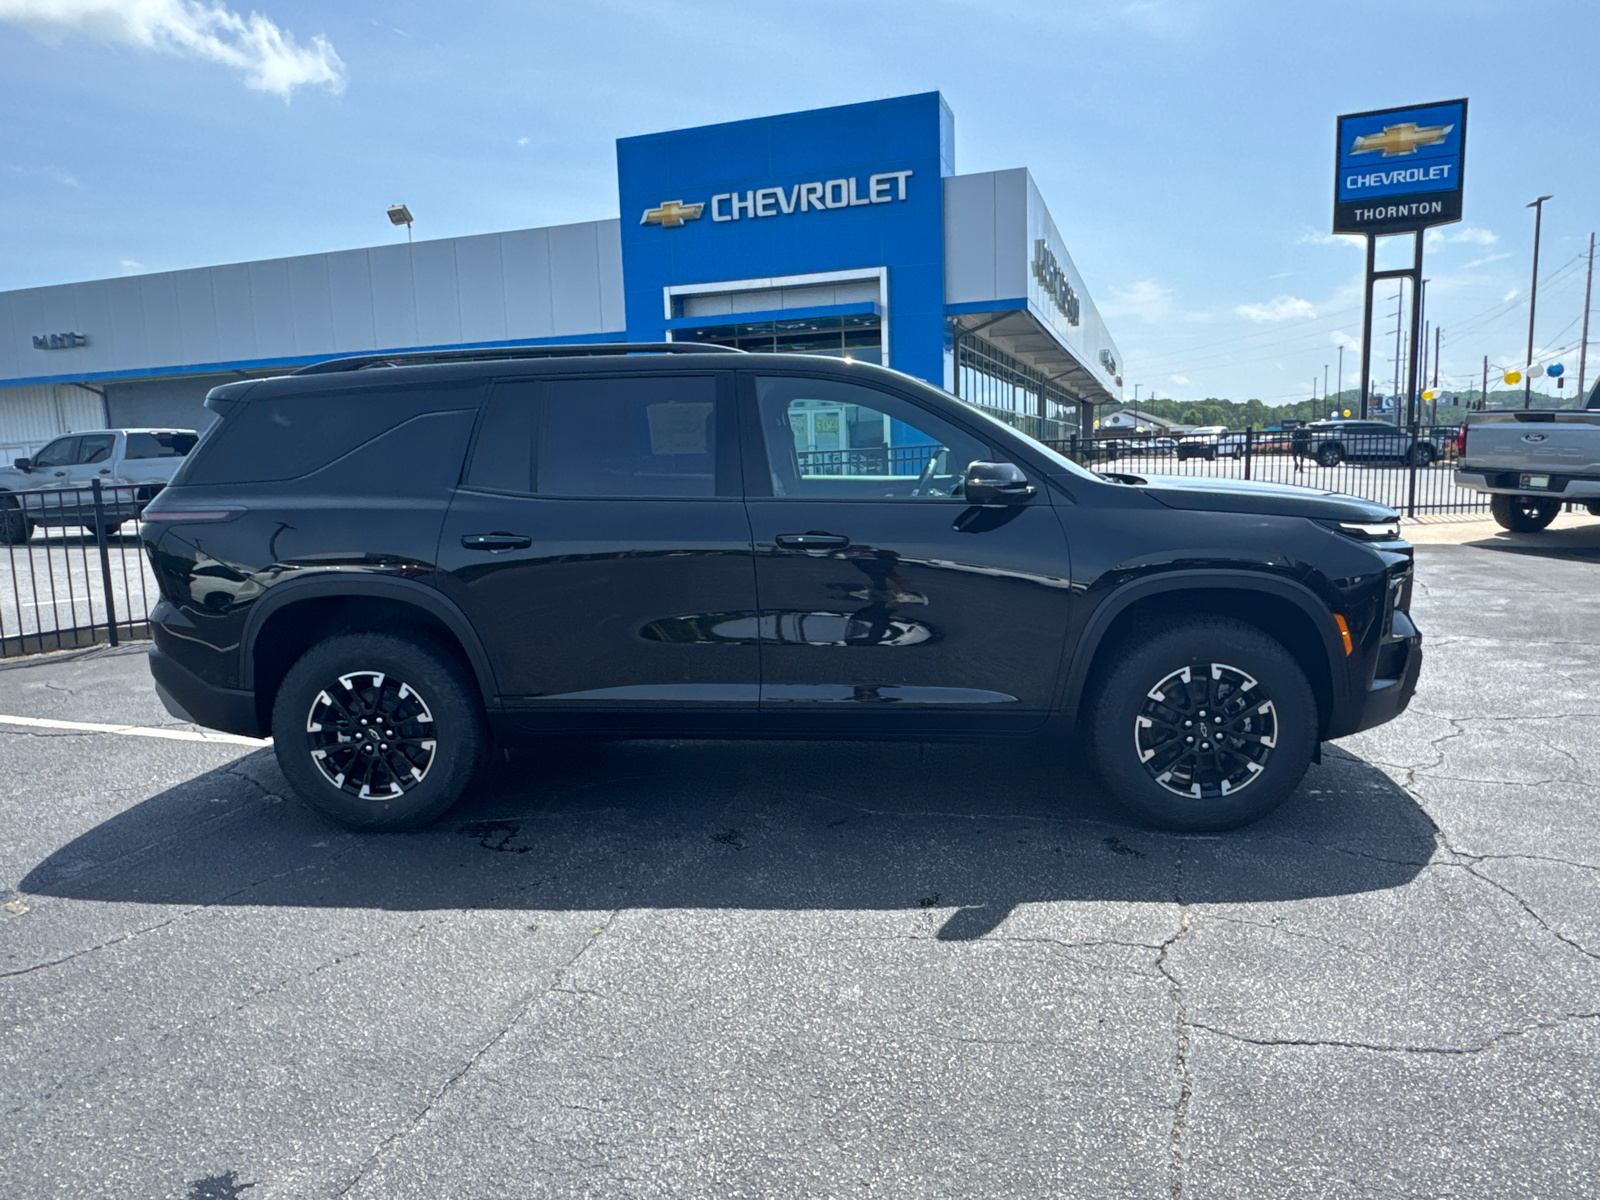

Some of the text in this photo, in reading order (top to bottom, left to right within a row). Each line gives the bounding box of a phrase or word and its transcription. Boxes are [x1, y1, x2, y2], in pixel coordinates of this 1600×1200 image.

[1346, 164, 1452, 189] CHEVROLET
[711, 170, 913, 222] CHEVROLET
[1354, 201, 1442, 221] THORNTON
